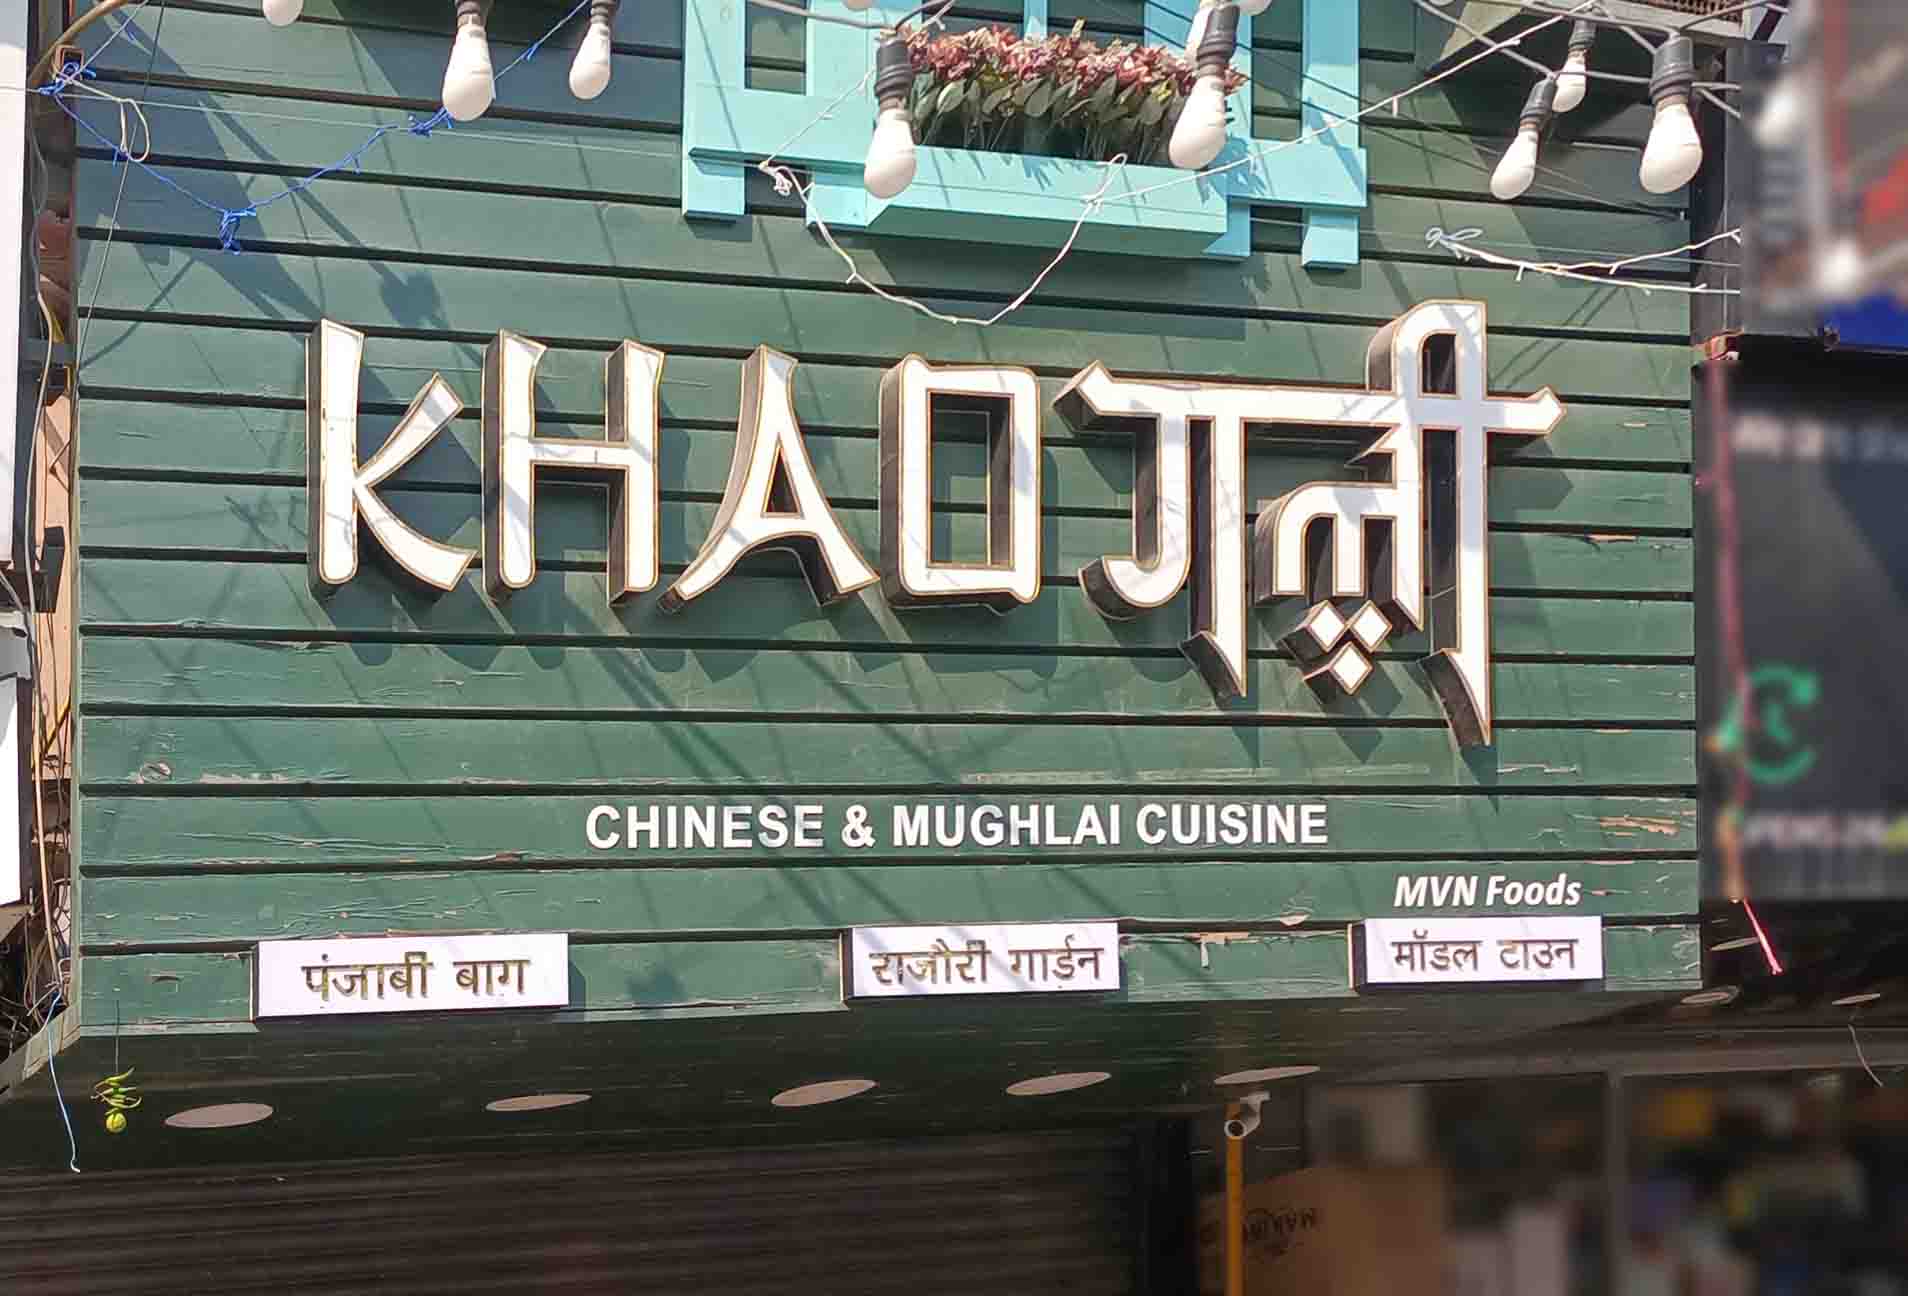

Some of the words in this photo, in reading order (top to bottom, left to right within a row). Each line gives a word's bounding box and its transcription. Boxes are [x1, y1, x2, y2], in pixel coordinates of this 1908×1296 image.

[308, 318, 1043, 606] KHAO
[1056, 299, 1567, 746] गली
[586, 804, 825, 850] CHINESE
[841, 803, 875, 849] &
[892, 803, 1121, 848] MUGHLAI
[1136, 802, 1329, 846] CUISINE
[1393, 875, 1479, 908] MVN
[1485, 872, 1583, 907] Foods
[869, 937, 993, 985] राजौरी
[1007, 933, 1106, 981] गार्डन
[1390, 927, 1484, 972] मॉडल
[1495, 937, 1580, 971] टाउन
[301, 951, 436, 1001] पंजाबी
[452, 958, 532, 997] बाग
